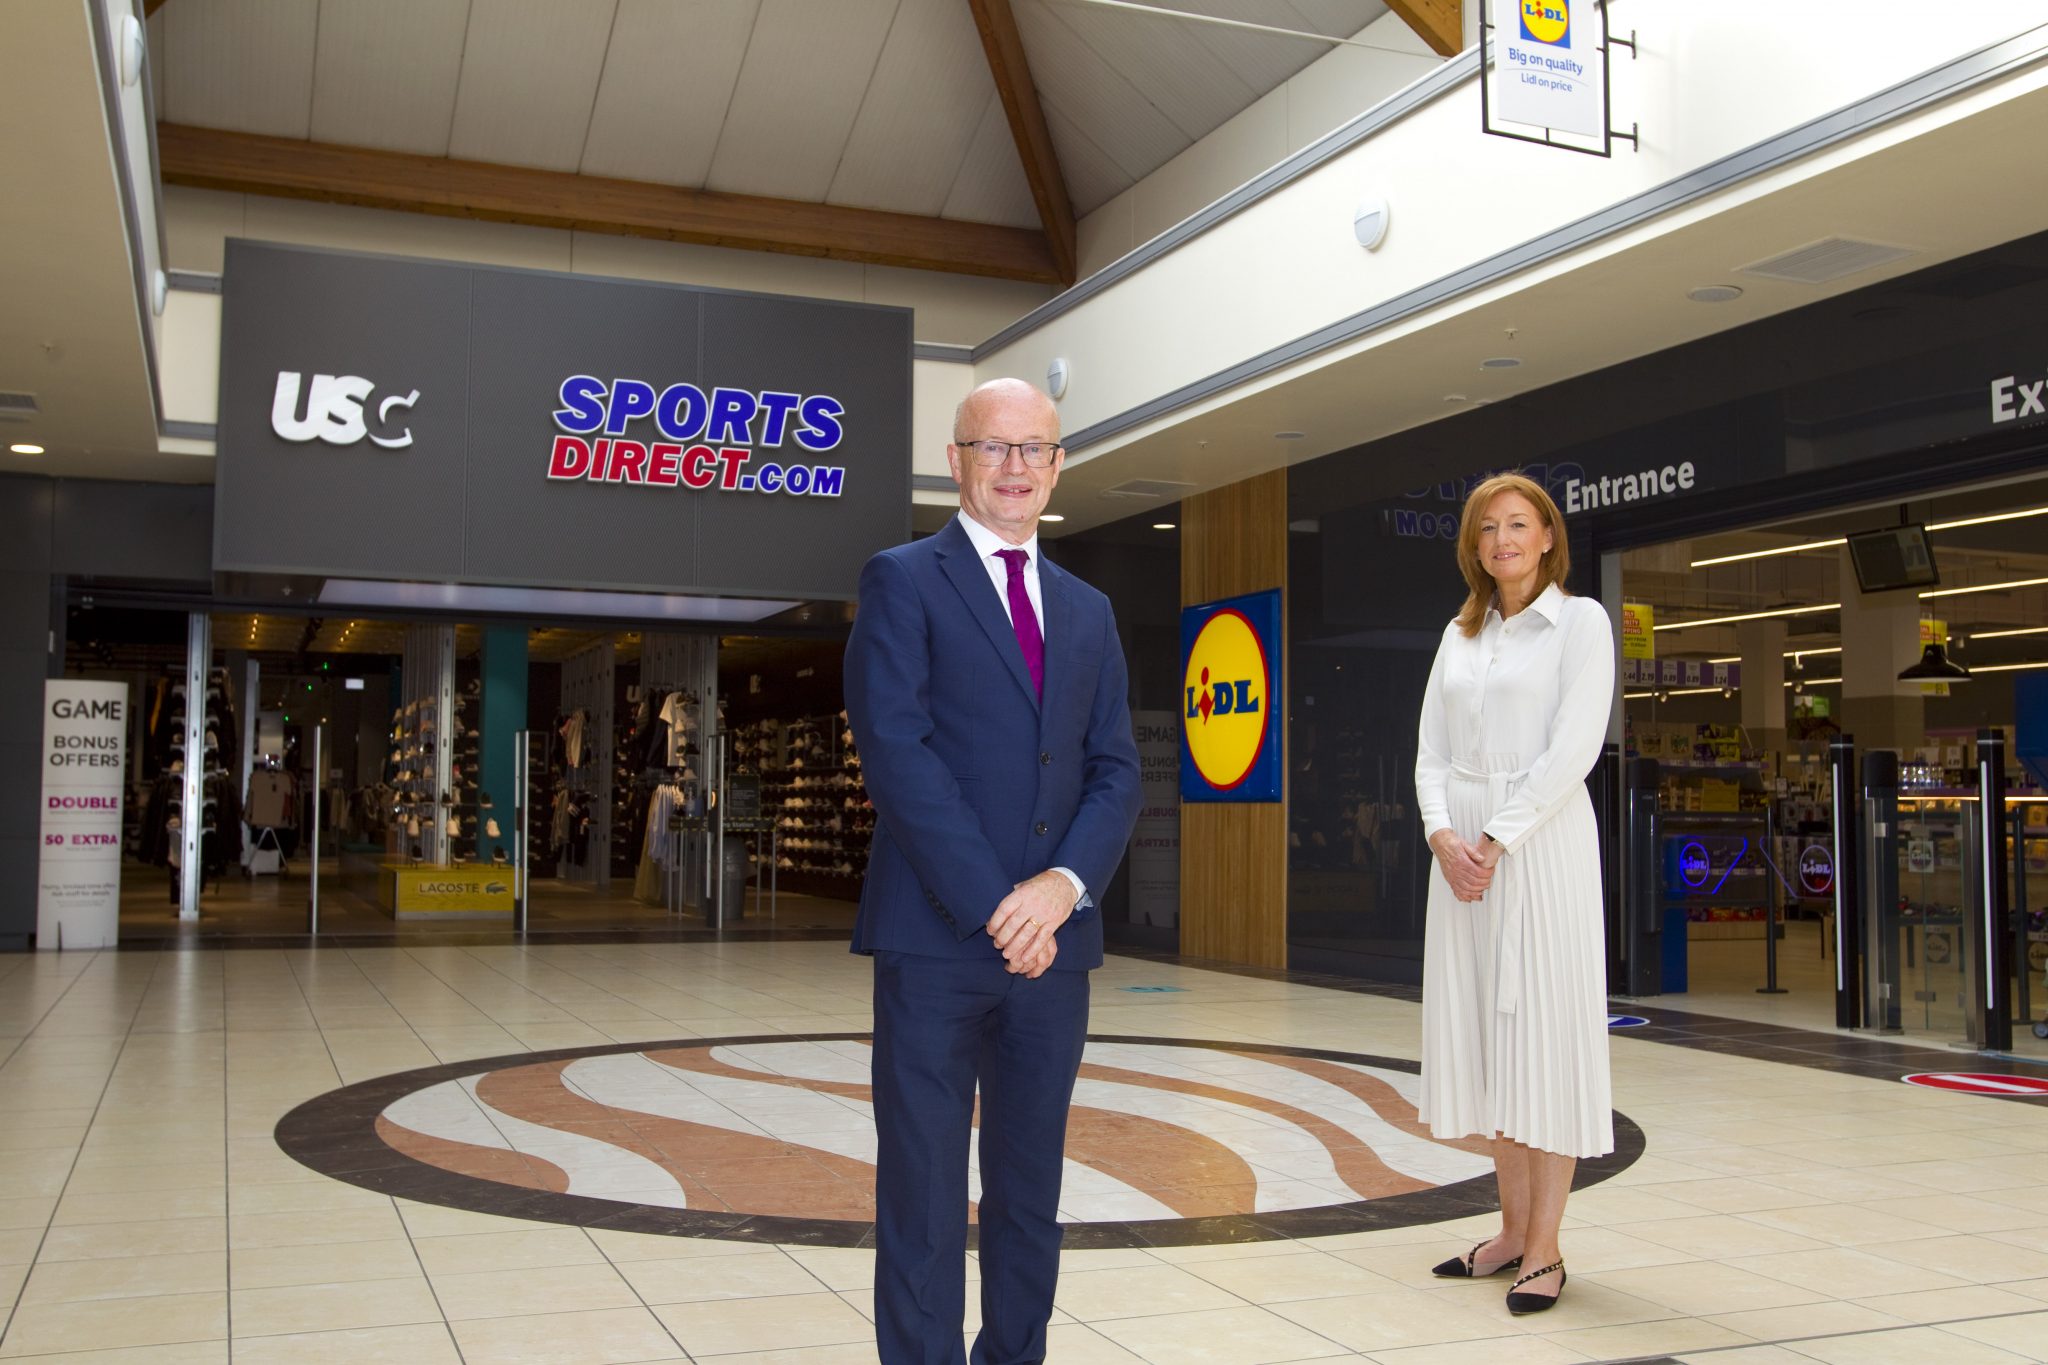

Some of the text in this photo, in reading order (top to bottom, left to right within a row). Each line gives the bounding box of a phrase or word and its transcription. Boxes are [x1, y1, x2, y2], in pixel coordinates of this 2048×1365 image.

[1508, 47, 1583, 76] Big on quality
[1521, 72, 1573, 92] Lidl on price
[1992, 370, 2048, 424] Ex
[552, 374, 846, 452] SPORTS
[547, 434, 846, 498] DIRECT.COM
[1566, 461, 1695, 514] Entrance
[52, 699, 122, 720] GAME
[53, 735, 119, 750] BONUS
[50, 753, 119, 767] OFFERS
[48, 797, 118, 809] DOUBLE
[45, 834, 118, 846] 50 EXTRA
[419, 883, 480, 894] LACOSTE
